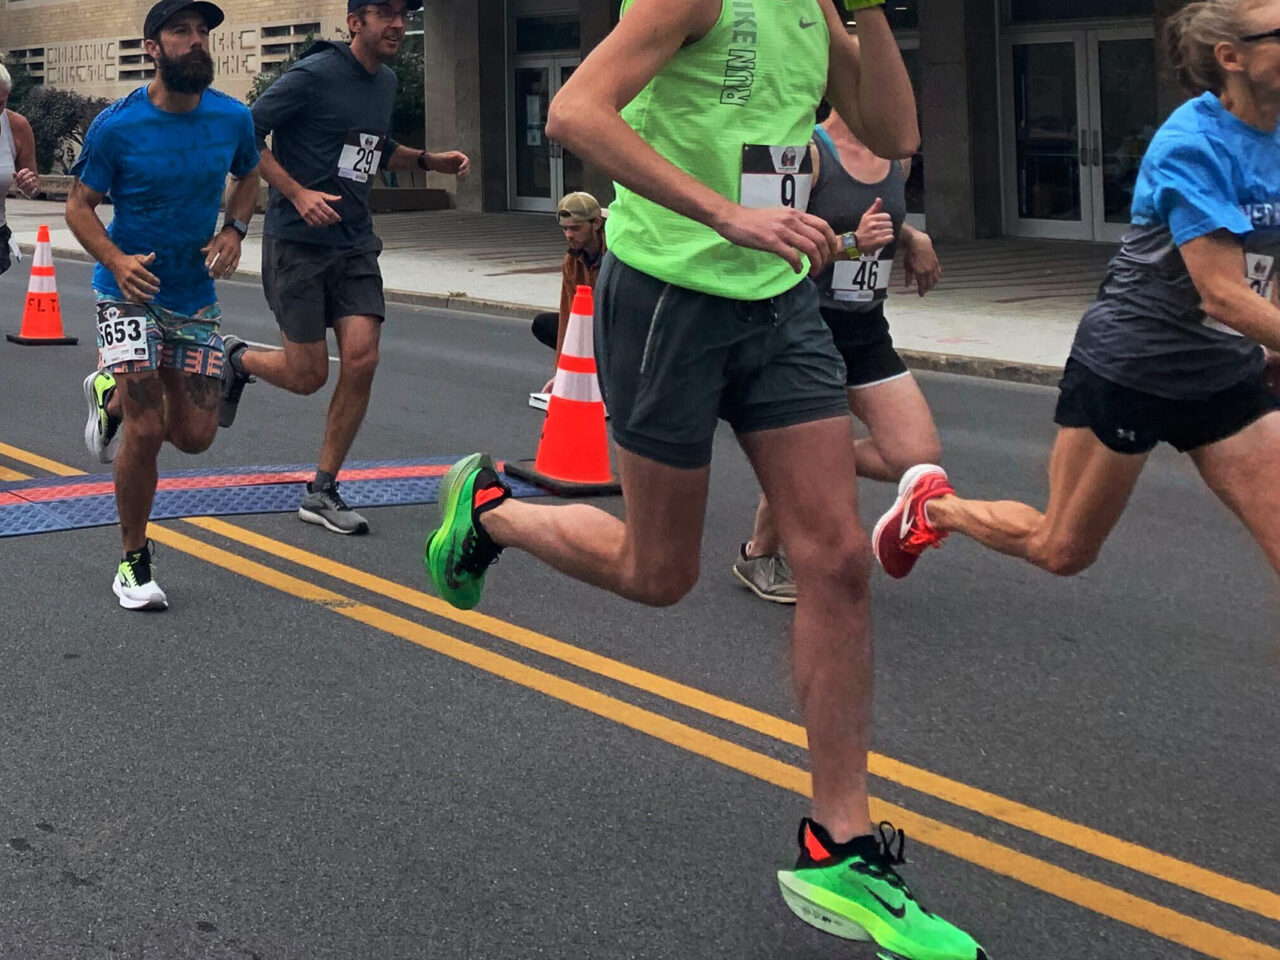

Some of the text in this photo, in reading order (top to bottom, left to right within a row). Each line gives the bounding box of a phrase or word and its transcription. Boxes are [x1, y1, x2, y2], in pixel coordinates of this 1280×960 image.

[720, 48, 756, 106] RUN
[352, 147, 374, 174] 29
[781, 173, 796, 208] 9
[852, 260, 879, 290] 46
